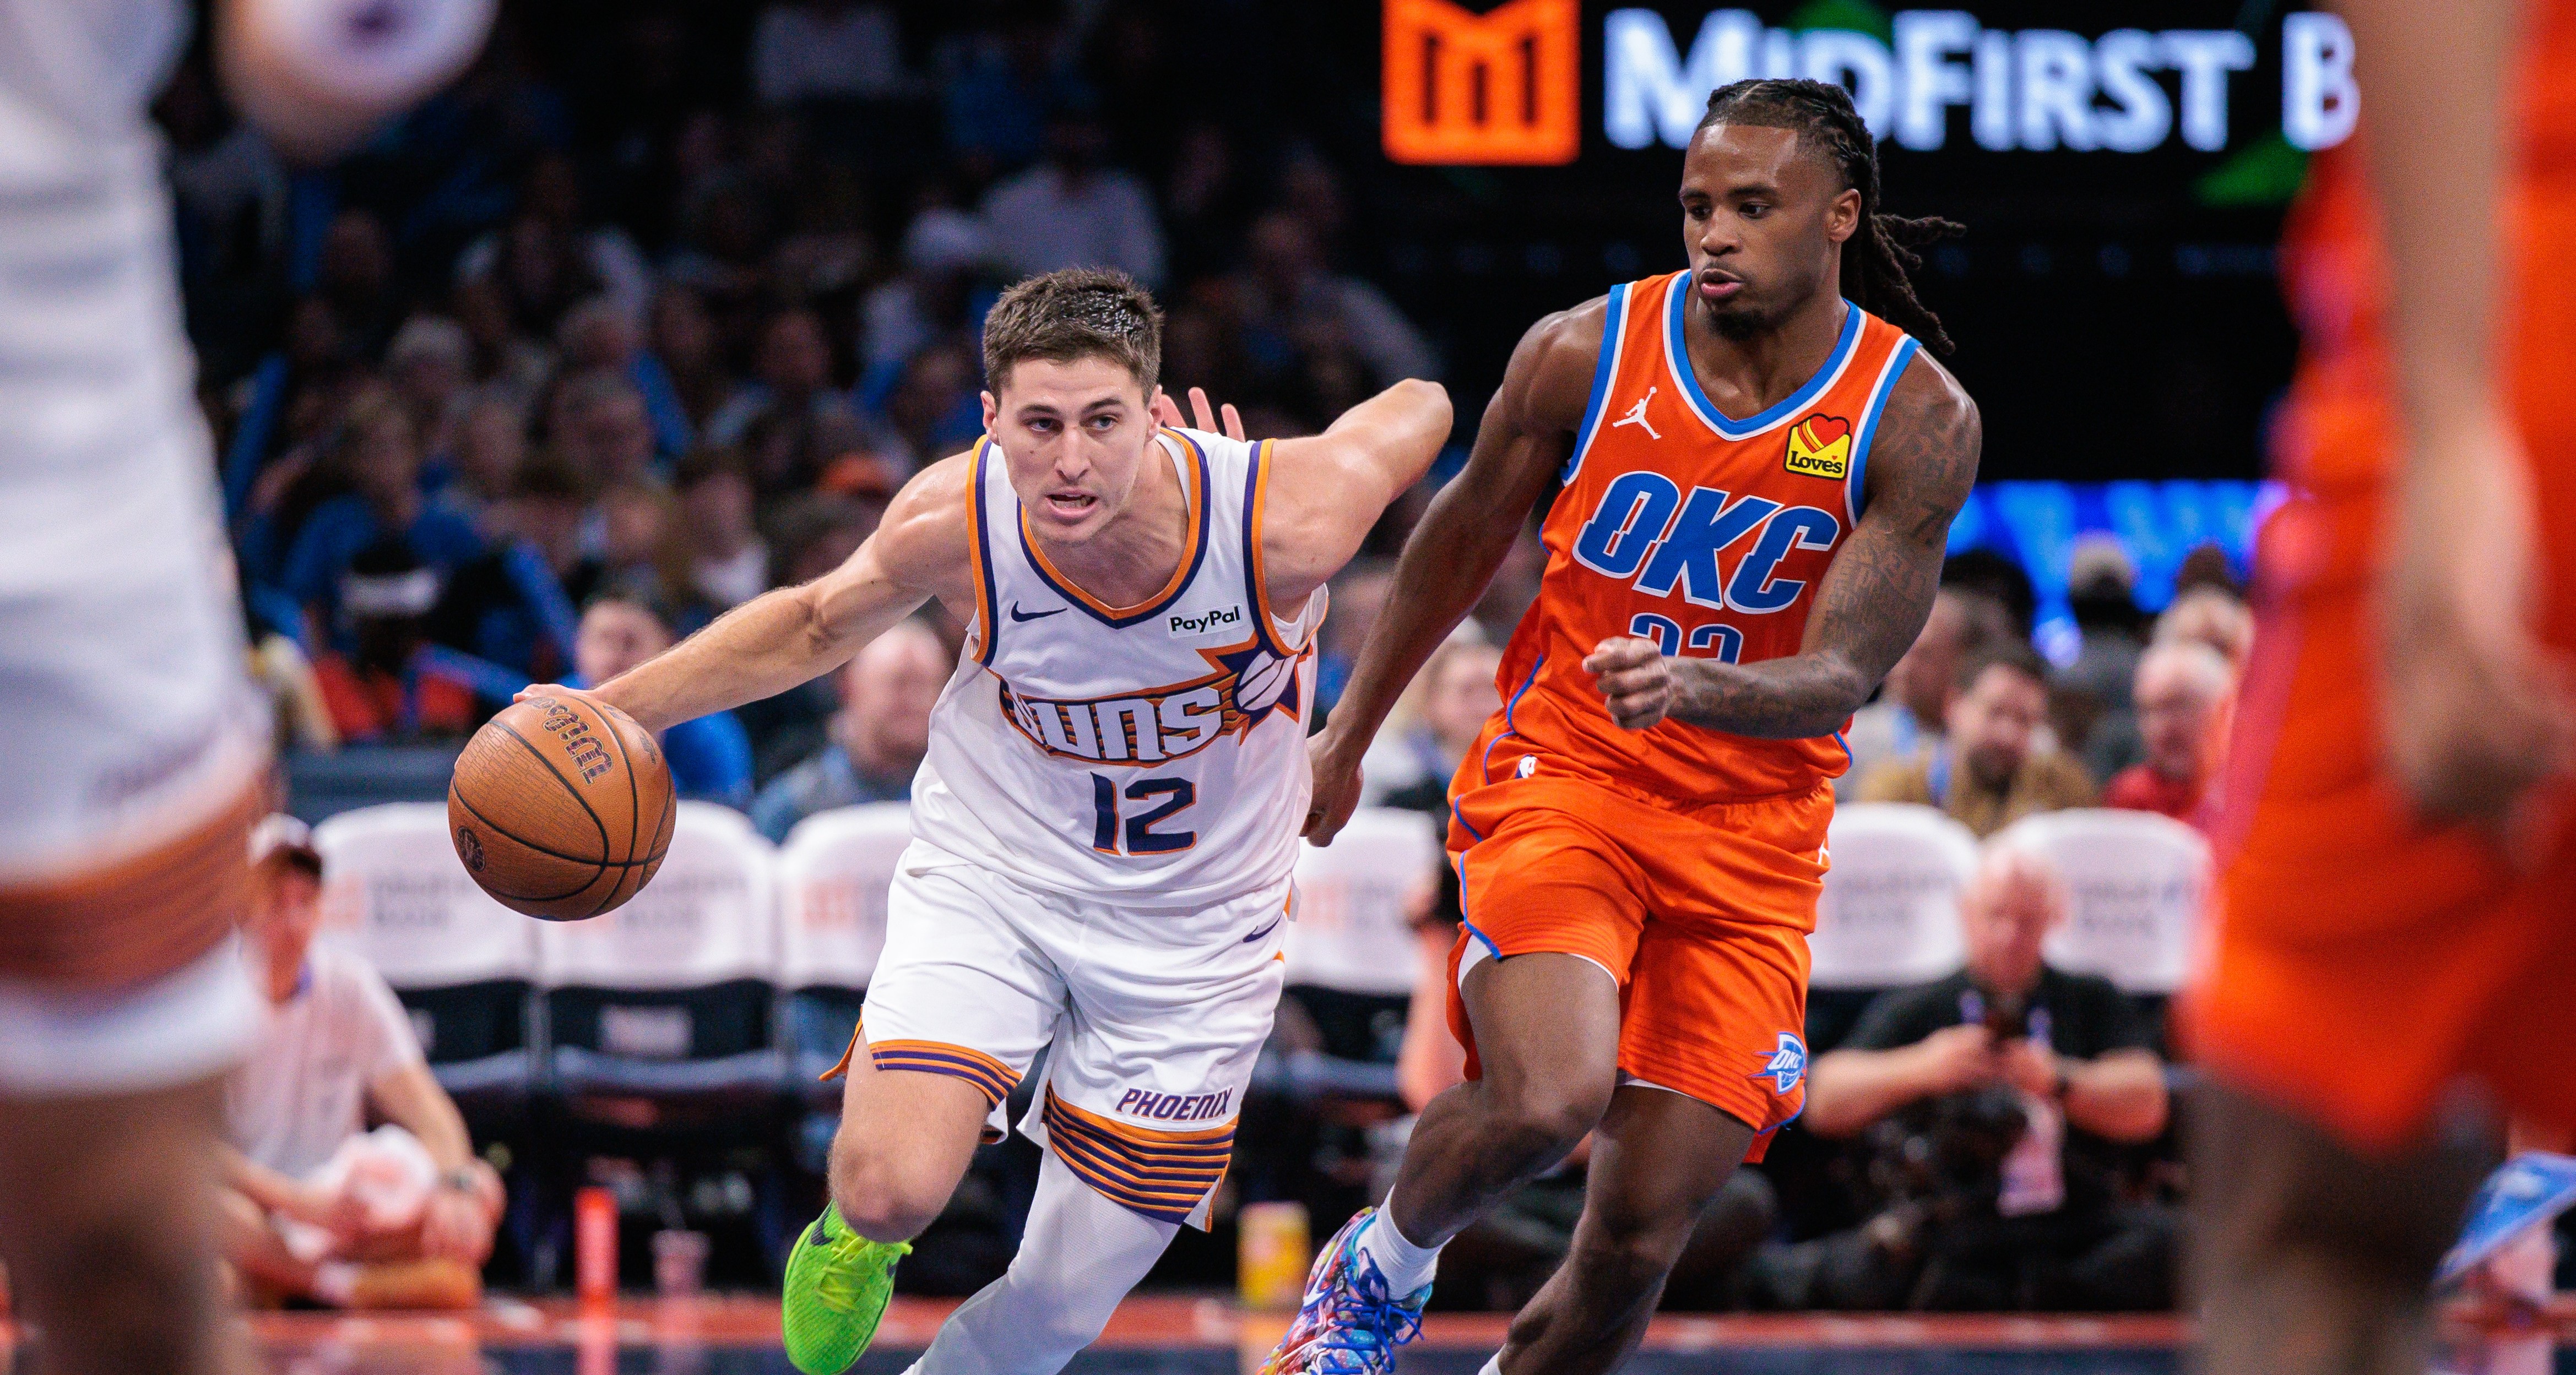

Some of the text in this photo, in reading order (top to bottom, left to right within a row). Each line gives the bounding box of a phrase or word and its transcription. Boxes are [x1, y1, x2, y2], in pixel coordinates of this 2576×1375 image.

[1572, 470, 1840, 615] OKC
[1170, 606, 1240, 633] PayPal
[523, 697, 614, 785] Wilso
[1090, 771, 1197, 856] 12
[1767, 1048, 1802, 1070] OKC
[1115, 1086, 1234, 1121] PHOENIX
